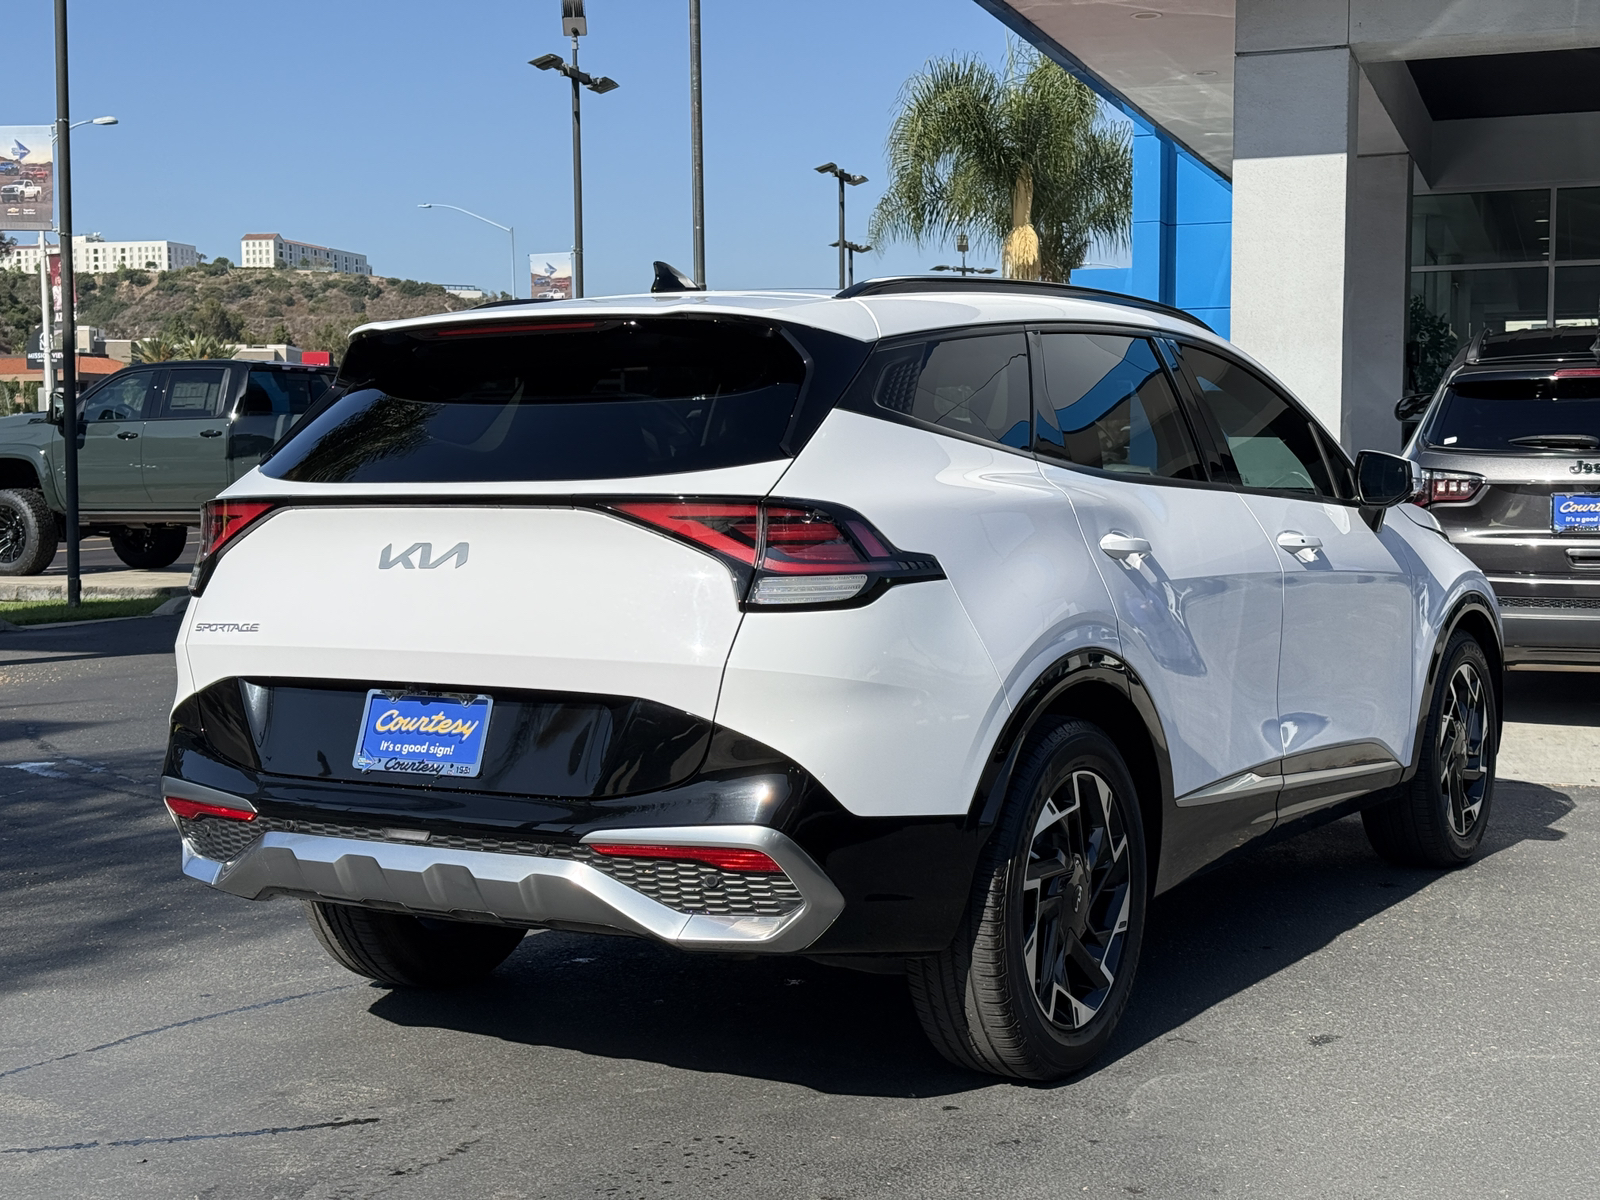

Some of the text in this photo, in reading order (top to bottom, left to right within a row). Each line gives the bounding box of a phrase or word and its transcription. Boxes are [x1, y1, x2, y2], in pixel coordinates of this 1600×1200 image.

[1581, 515, 1599, 523] good
[378, 542, 470, 570] KIA
[195, 622, 260, 632] SPORTAGE
[375, 709, 479, 741] Courtesy
[380, 740, 455, 757] It's a good sign!
[384, 756, 444, 776] Courtesy
